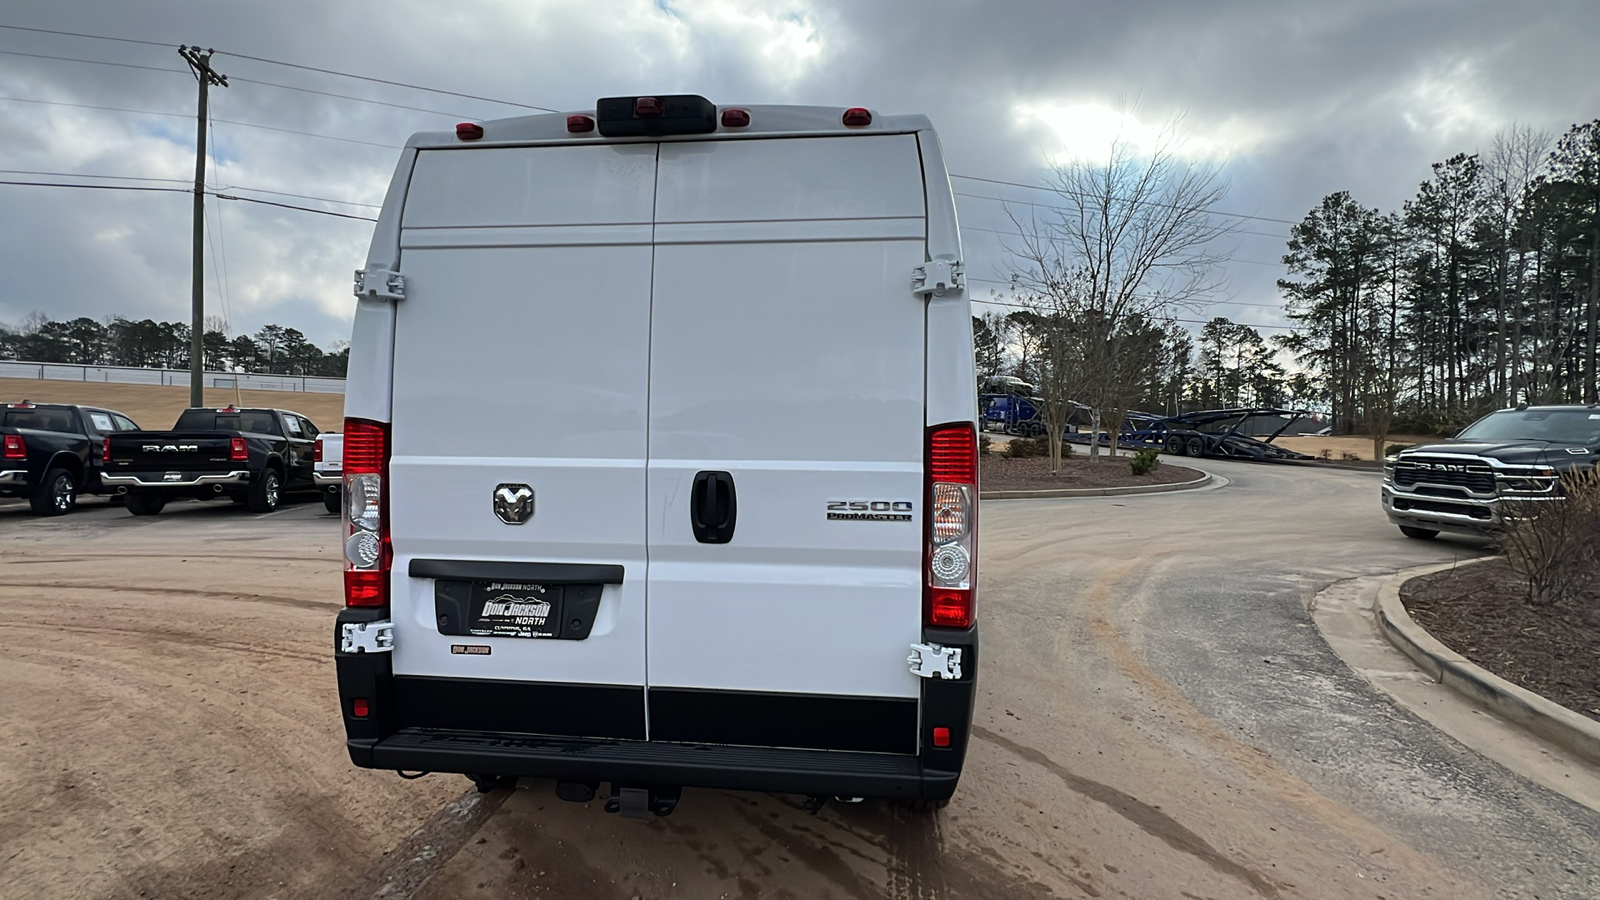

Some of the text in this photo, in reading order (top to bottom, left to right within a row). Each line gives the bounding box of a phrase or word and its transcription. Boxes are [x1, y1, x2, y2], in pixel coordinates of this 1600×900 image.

[1416, 462, 1465, 472] RAM
[827, 500, 912, 511] 2500
[491, 582, 501, 590] DON
[501, 583, 522, 591] JACKSON
[481, 602, 551, 618] DON JACKSON
[515, 616, 546, 626] NORTH
